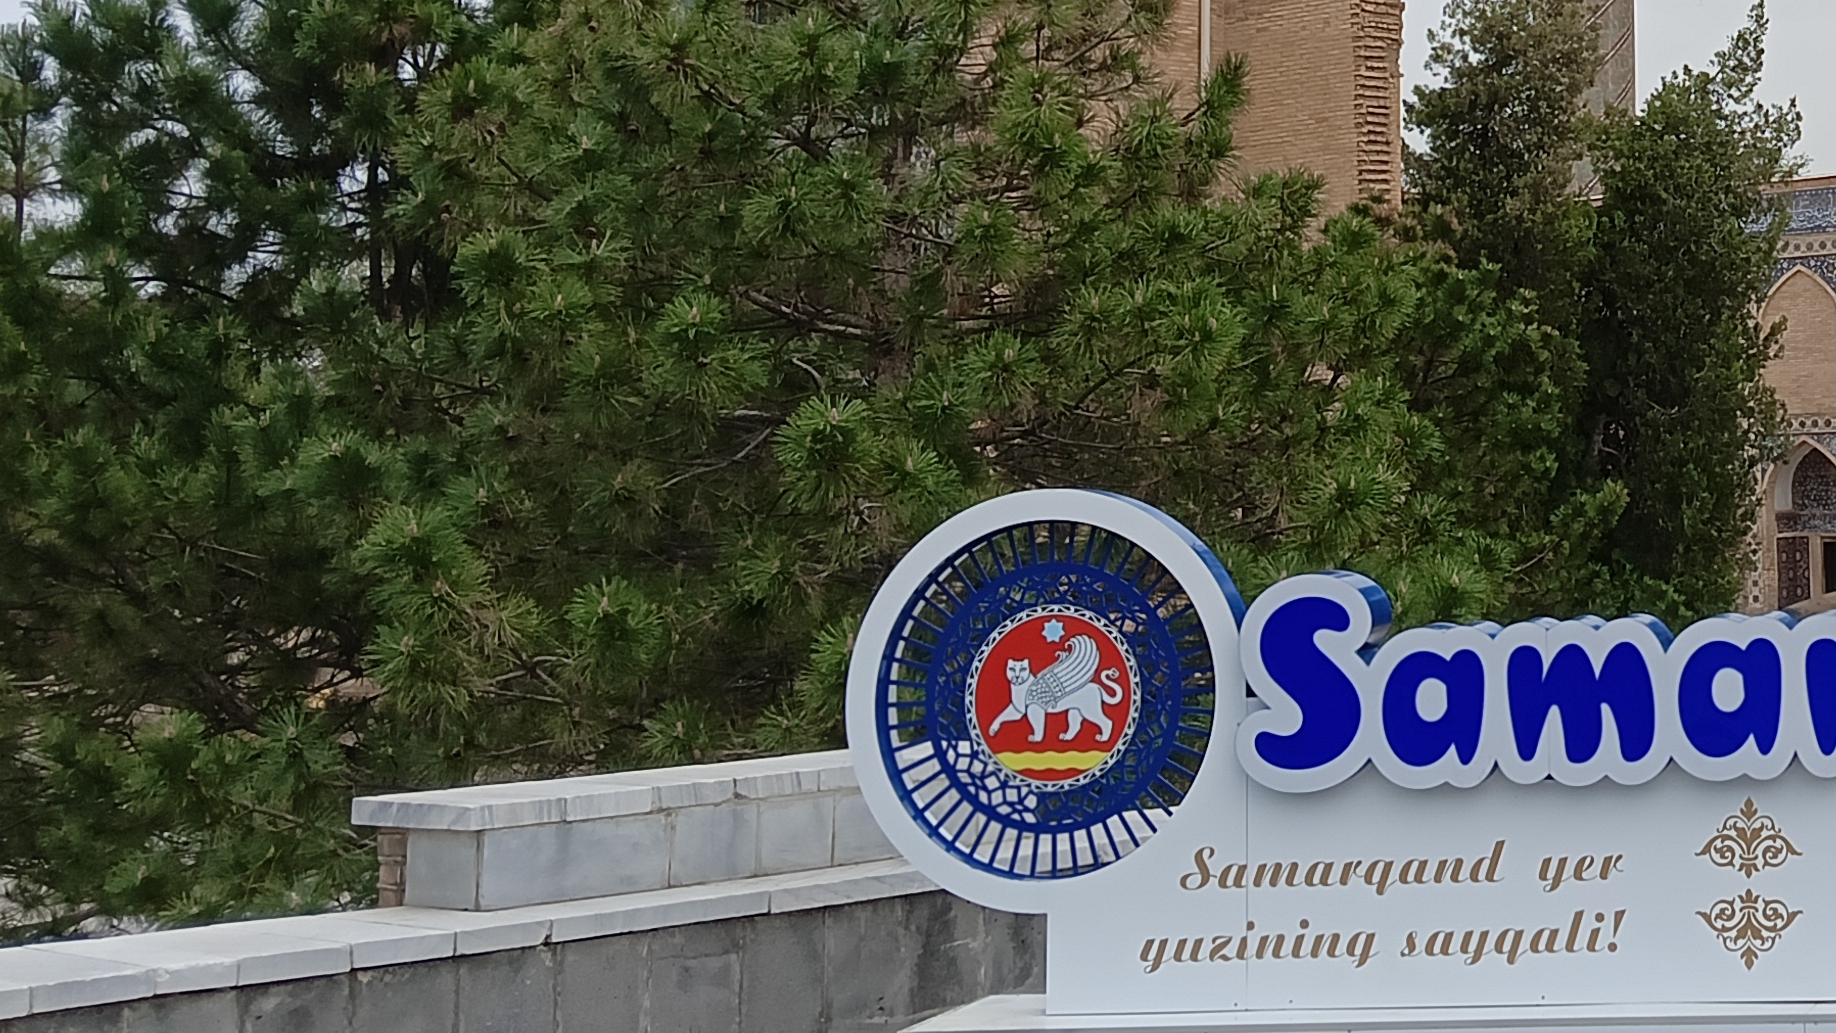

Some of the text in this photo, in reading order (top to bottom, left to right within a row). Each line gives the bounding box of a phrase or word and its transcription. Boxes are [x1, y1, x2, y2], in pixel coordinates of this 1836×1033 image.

[1180, 840, 1625, 896] Samarqand yer
[1139, 909, 1627, 974] yuzining sayqali!
